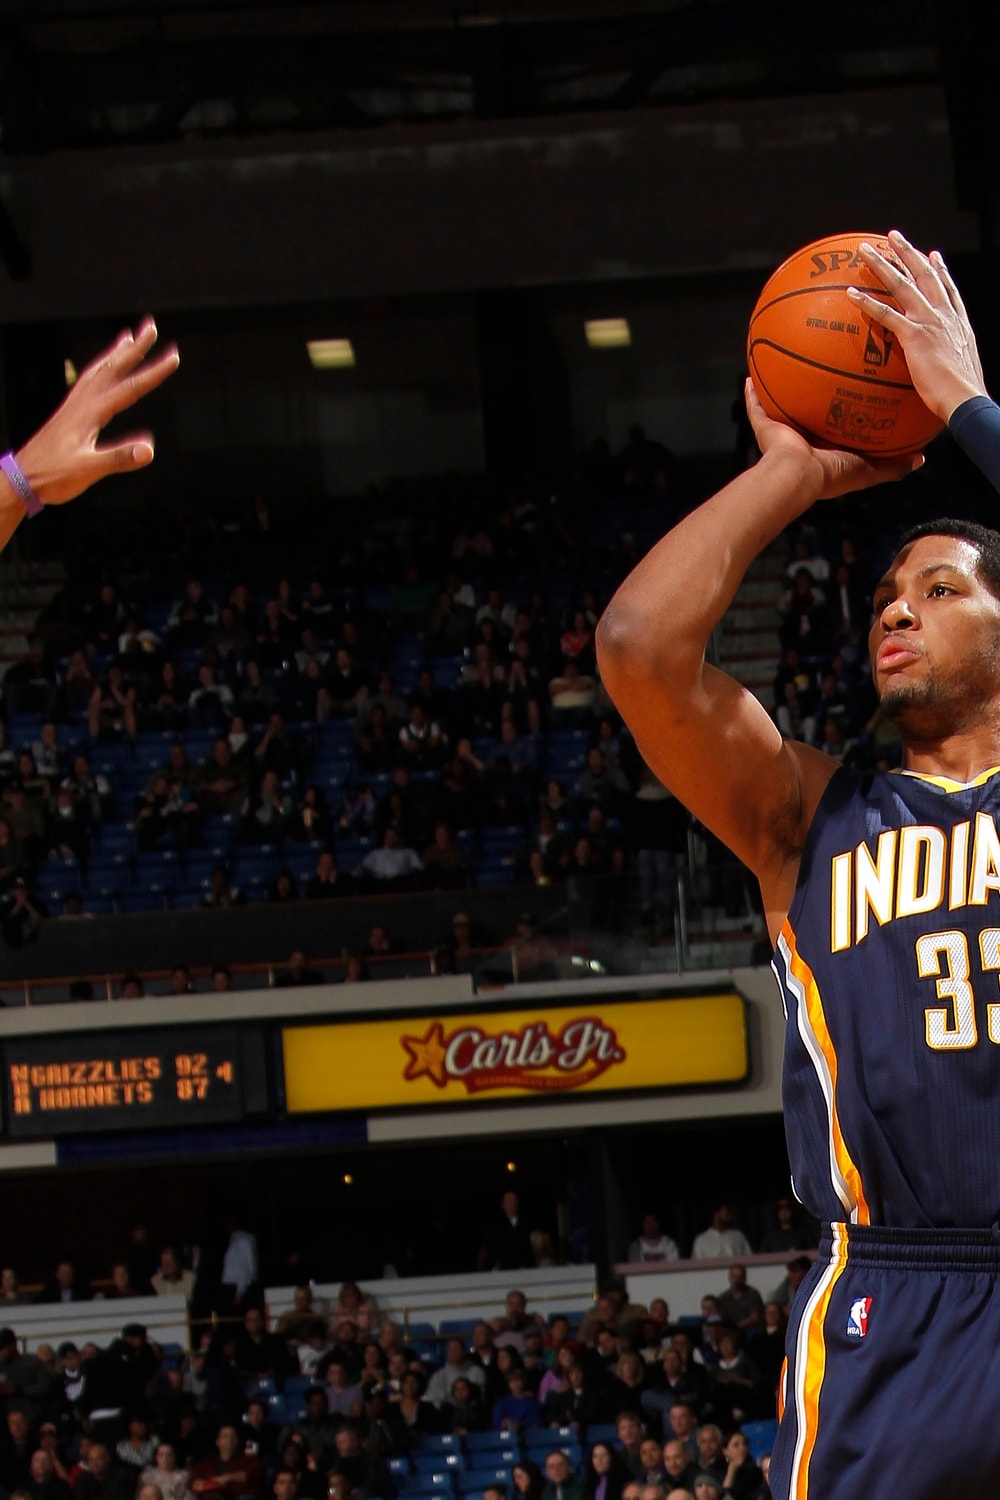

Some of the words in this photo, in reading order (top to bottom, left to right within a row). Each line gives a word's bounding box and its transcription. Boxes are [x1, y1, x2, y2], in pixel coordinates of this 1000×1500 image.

[830, 322, 845, 332] GAME
[846, 324, 860, 335] BALL
[445, 1024, 554, 1077] Carl's
[558, 1020, 621, 1071] Jr.
[30, 1055, 162, 1088] GRIZZLIES
[174, 1052, 208, 1077] 92
[39, 1079, 154, 1111] HORNETS
[847, 1326, 860, 1335] NBA
